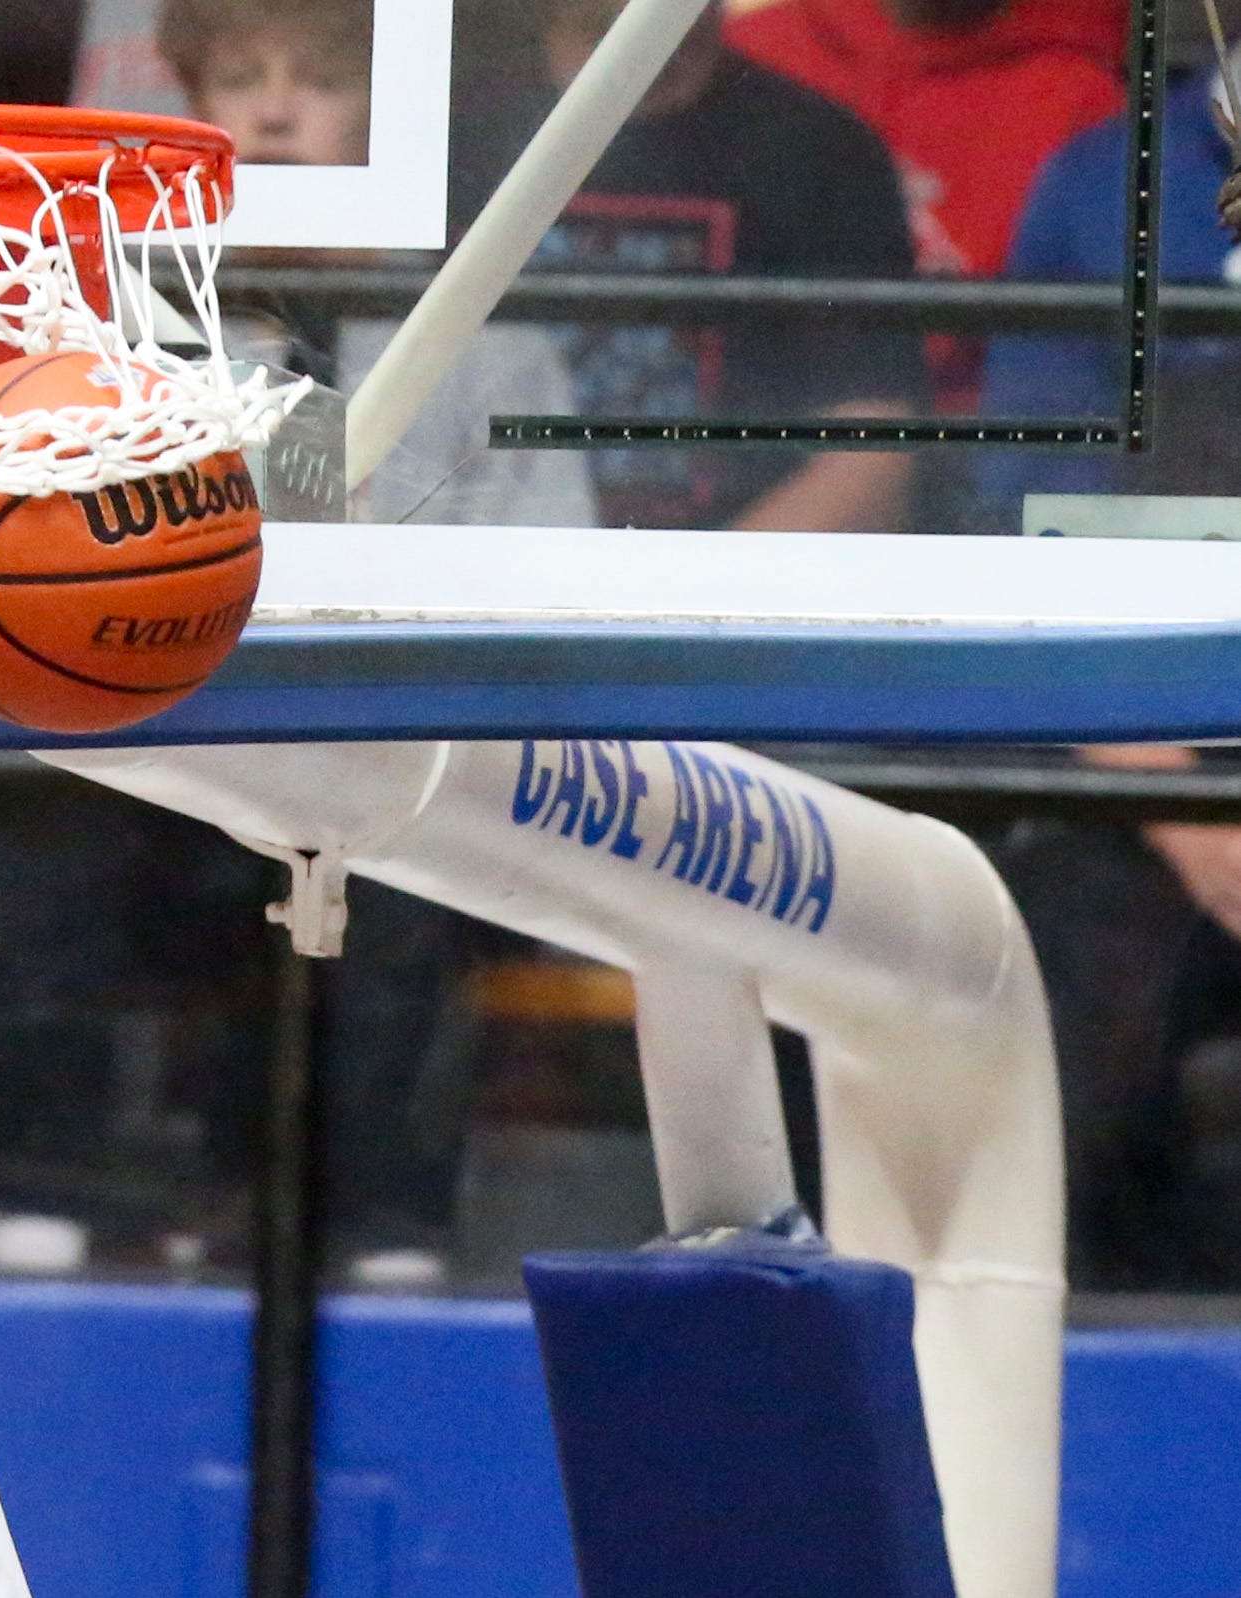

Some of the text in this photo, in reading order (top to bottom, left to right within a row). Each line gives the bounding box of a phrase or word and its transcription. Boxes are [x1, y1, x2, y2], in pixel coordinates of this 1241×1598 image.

[92, 597, 252, 646] EVOLUT
[512, 740, 834, 933] CASE ARENA
